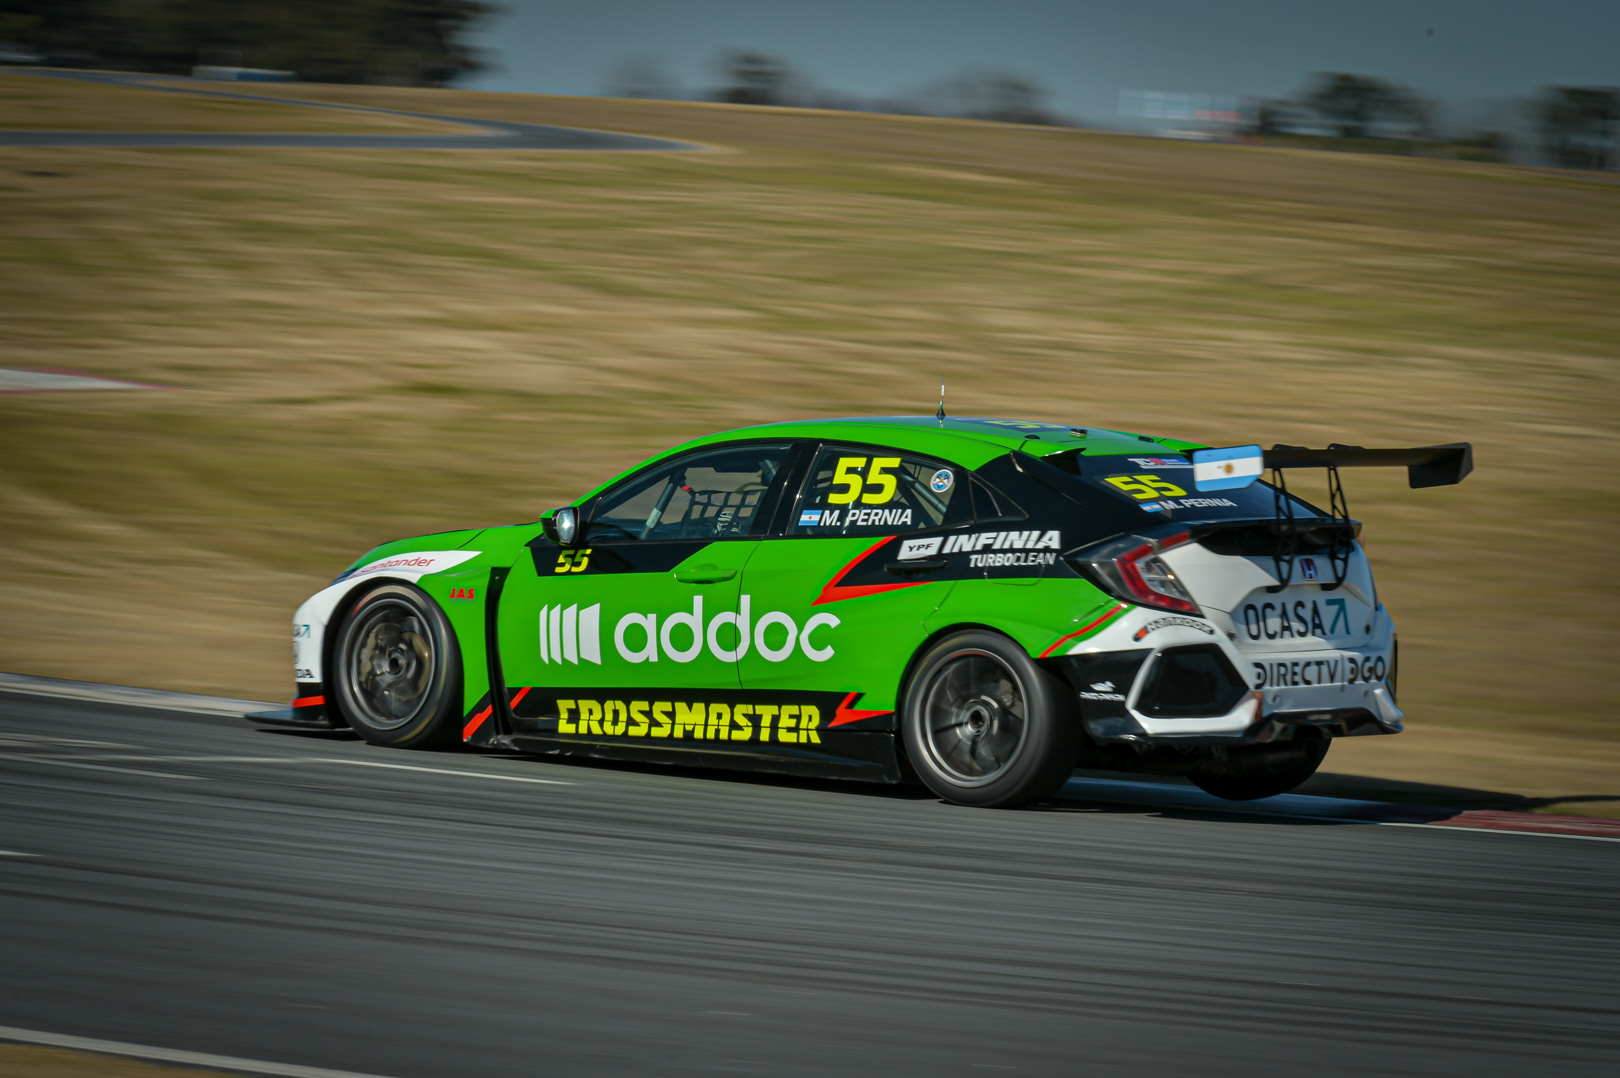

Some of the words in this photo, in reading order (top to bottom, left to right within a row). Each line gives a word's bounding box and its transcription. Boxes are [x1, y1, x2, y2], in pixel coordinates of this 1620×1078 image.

[827, 456, 902, 504] 55
[1104, 474, 1188, 500] 55
[820, 509, 841, 526] M.
[845, 508, 912, 526] PERNIA
[1159, 500, 1184, 510] M.
[1182, 498, 1238, 508] PERNIA
[907, 542, 935, 553] YPF
[942, 530, 1061, 554] INFINIA
[554, 548, 592, 573] 55
[969, 552, 1057, 568] TURBOCLEAN
[614, 594, 841, 664] addoc
[1244, 600, 1327, 641] OCASA
[1252, 659, 1339, 690] DIRECTV
[556, 699, 822, 744] CROSSMASTER
